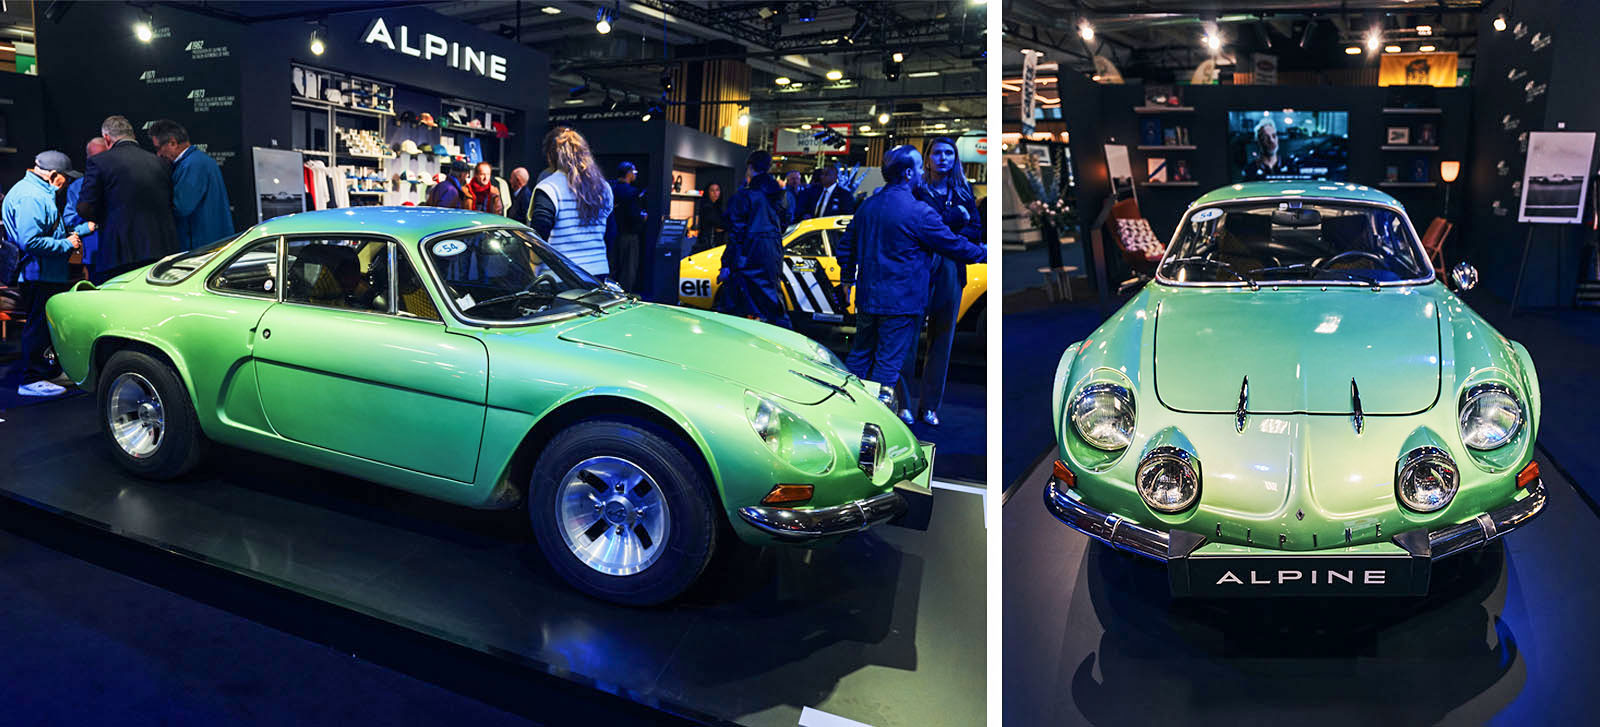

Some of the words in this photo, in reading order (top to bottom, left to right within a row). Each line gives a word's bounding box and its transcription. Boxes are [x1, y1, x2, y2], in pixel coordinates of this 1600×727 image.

[365, 17, 507, 82] ALPINE
[442, 243, 459, 253] 54
[681, 279, 710, 297] elf
[1215, 522, 1382, 549] ALPINE
[1216, 570, 1386, 585] ALPINE
